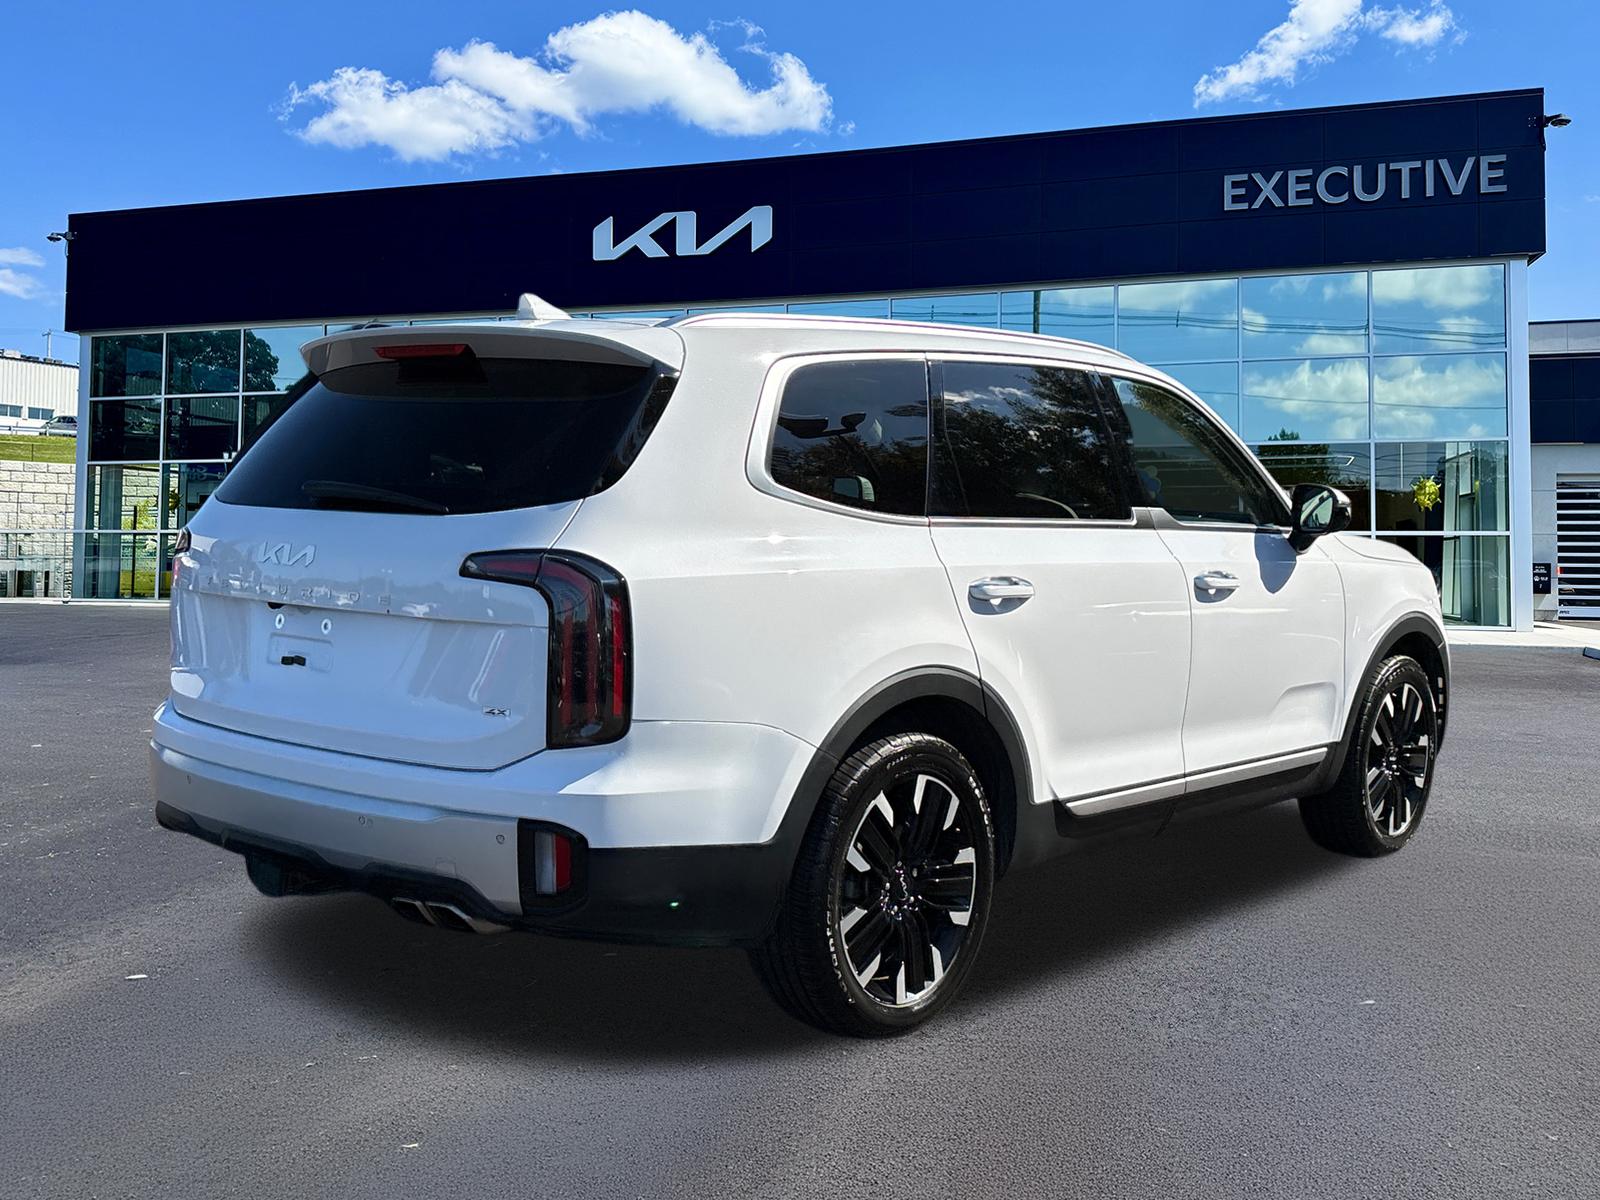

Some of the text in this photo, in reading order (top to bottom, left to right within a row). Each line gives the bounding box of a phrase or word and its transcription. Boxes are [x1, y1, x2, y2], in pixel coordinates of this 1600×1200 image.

[1223, 154, 1508, 211] EXECUTIVE
[593, 205, 772, 261] KIA
[258, 541, 317, 568] KIA
